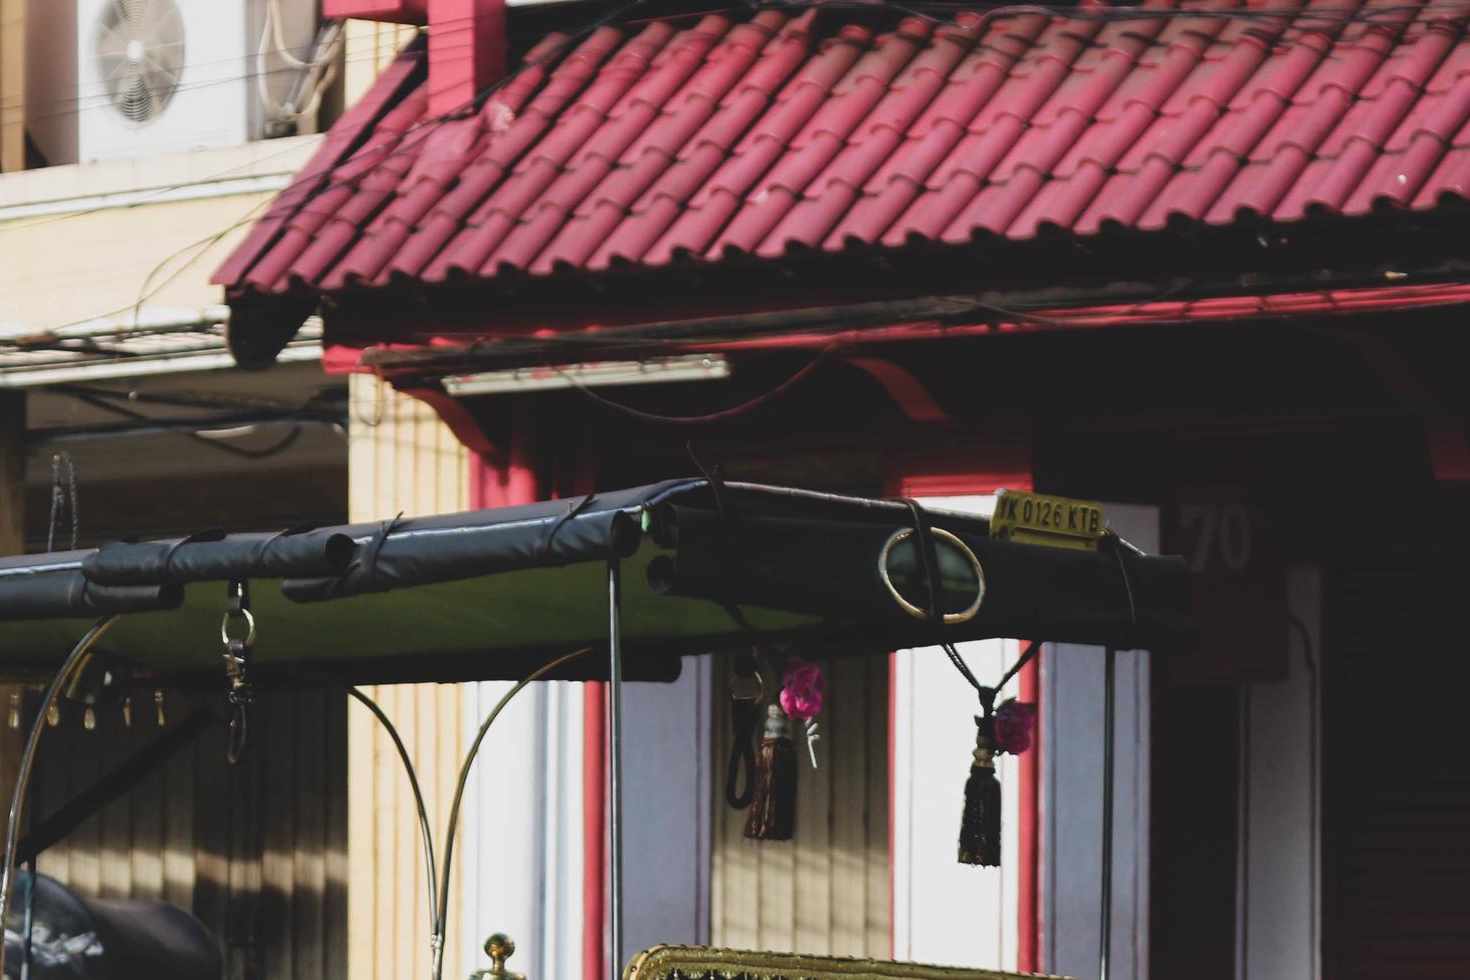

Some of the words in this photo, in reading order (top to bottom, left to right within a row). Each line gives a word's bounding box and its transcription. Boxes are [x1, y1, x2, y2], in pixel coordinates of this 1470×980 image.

[1023, 499, 1062, 527] 0126
[1068, 506, 1100, 532] KTB
[1179, 502, 1252, 573] 70
